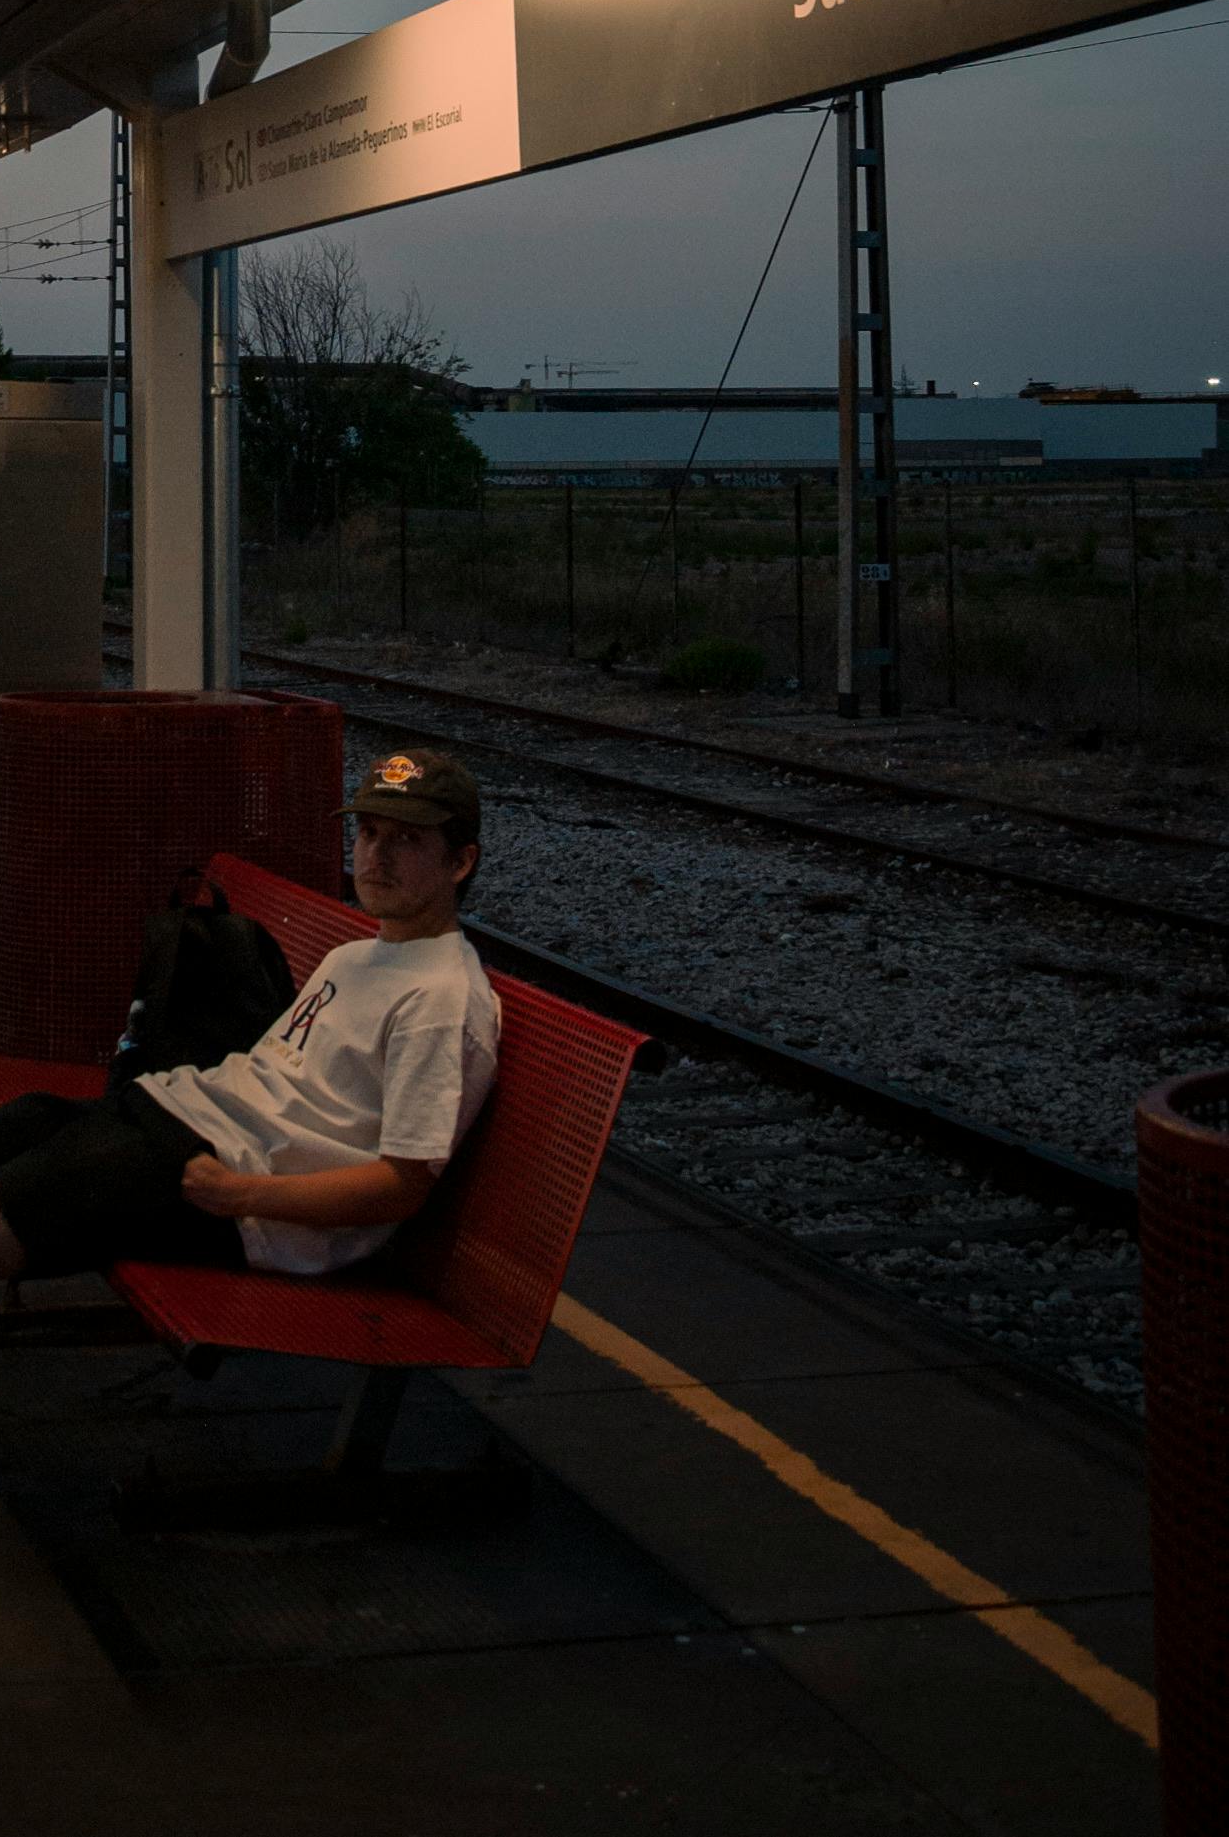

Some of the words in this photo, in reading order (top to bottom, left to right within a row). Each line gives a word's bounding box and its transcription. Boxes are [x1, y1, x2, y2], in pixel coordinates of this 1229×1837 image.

[224, 130, 253, 194] Sol
[329, 120, 408, 160] Alameda-Peguerinos
[435, 104, 463, 129] Escorial
